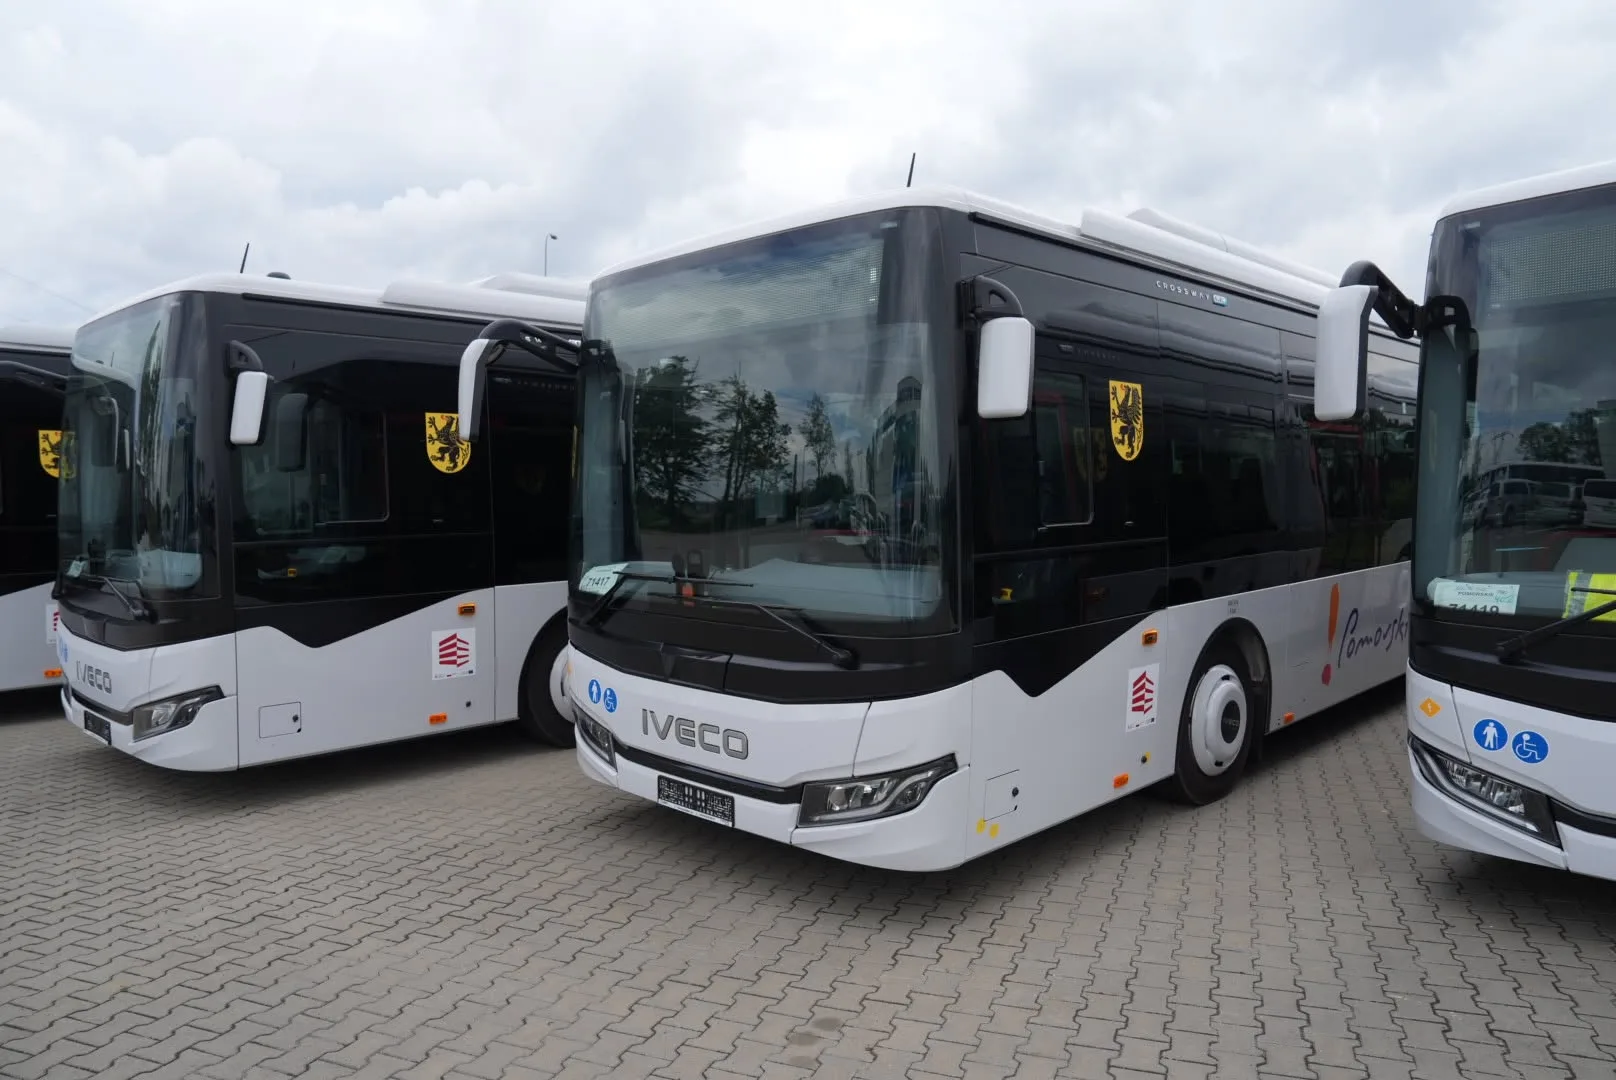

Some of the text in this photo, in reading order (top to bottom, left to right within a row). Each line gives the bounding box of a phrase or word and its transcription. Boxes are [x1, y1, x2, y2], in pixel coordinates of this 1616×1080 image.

[1156, 280, 1210, 300] CROSSWAY
[76, 660, 112, 694] IVECO
[642, 708, 748, 760] IVECO
